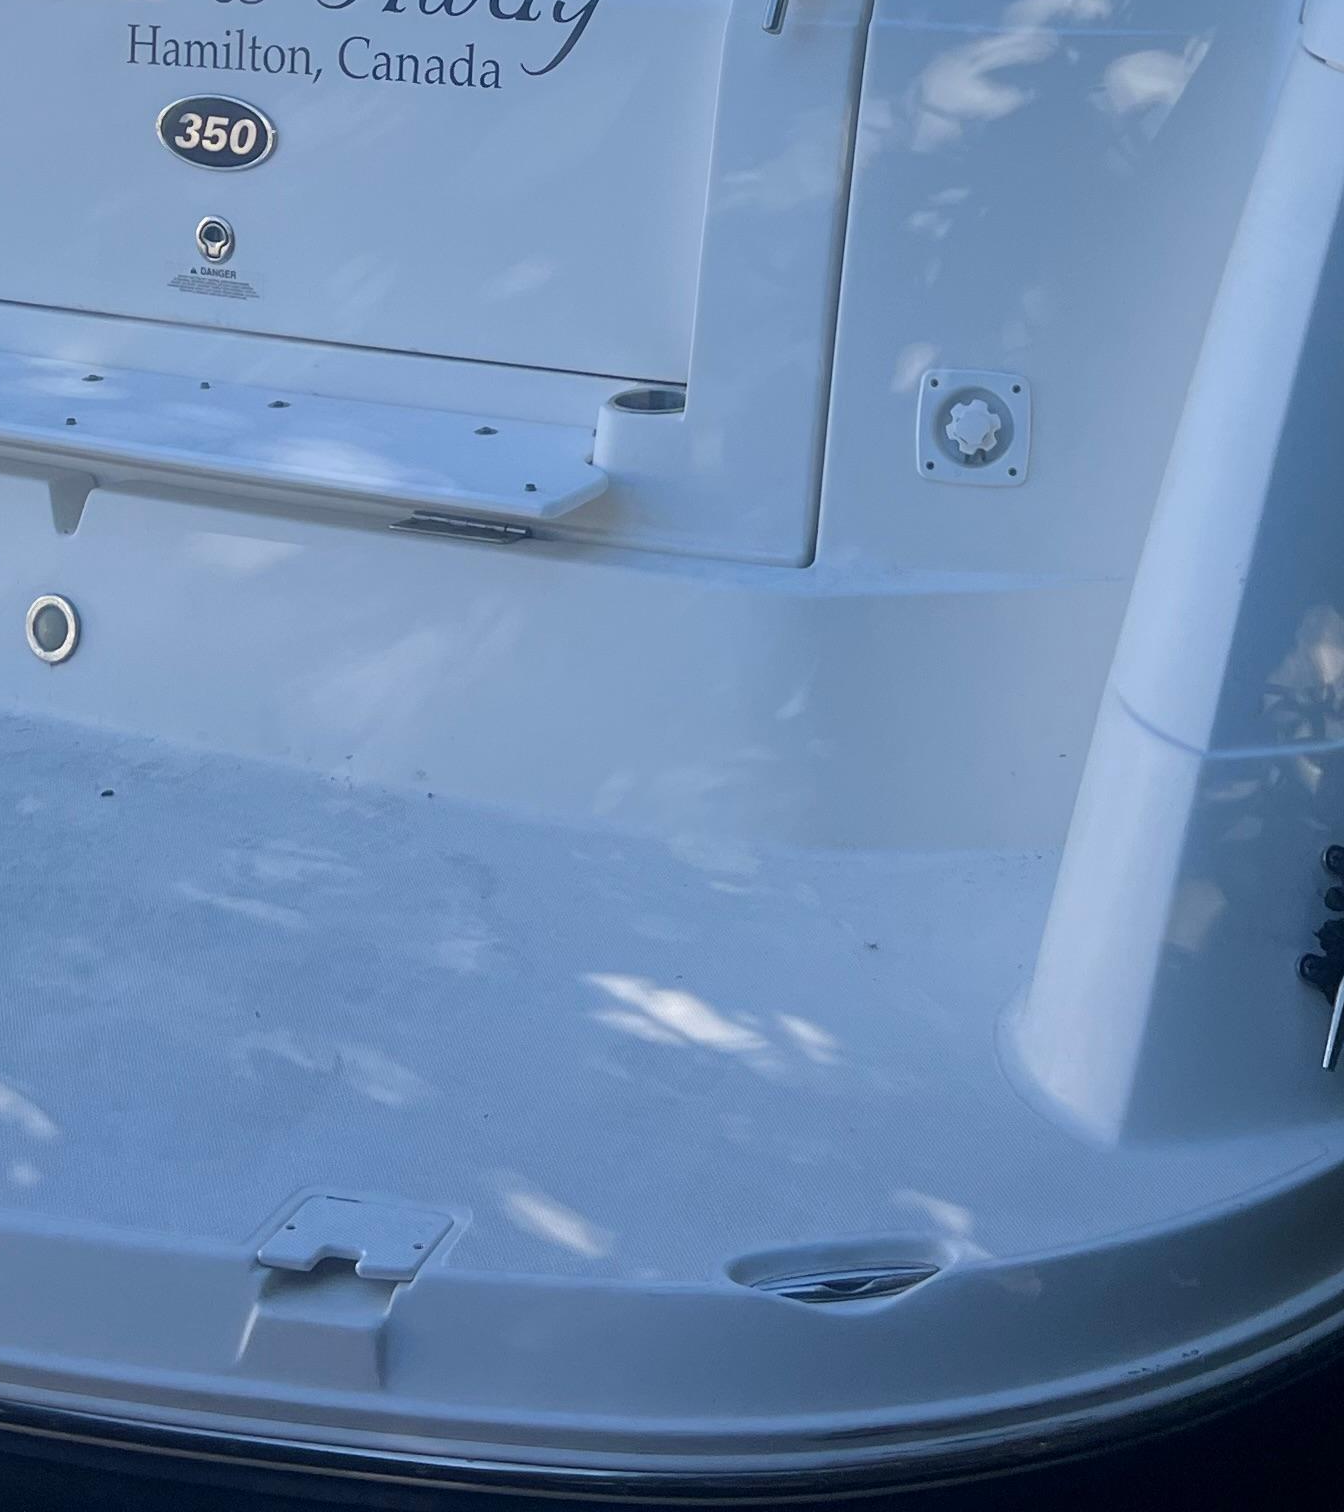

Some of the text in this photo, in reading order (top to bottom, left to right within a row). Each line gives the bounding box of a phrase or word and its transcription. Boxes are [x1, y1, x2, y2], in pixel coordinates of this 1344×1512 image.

[126, 23, 502, 89] Hamilton, Canada
[174, 112, 257, 155] 350
[200, 266, 237, 280] DANGER
